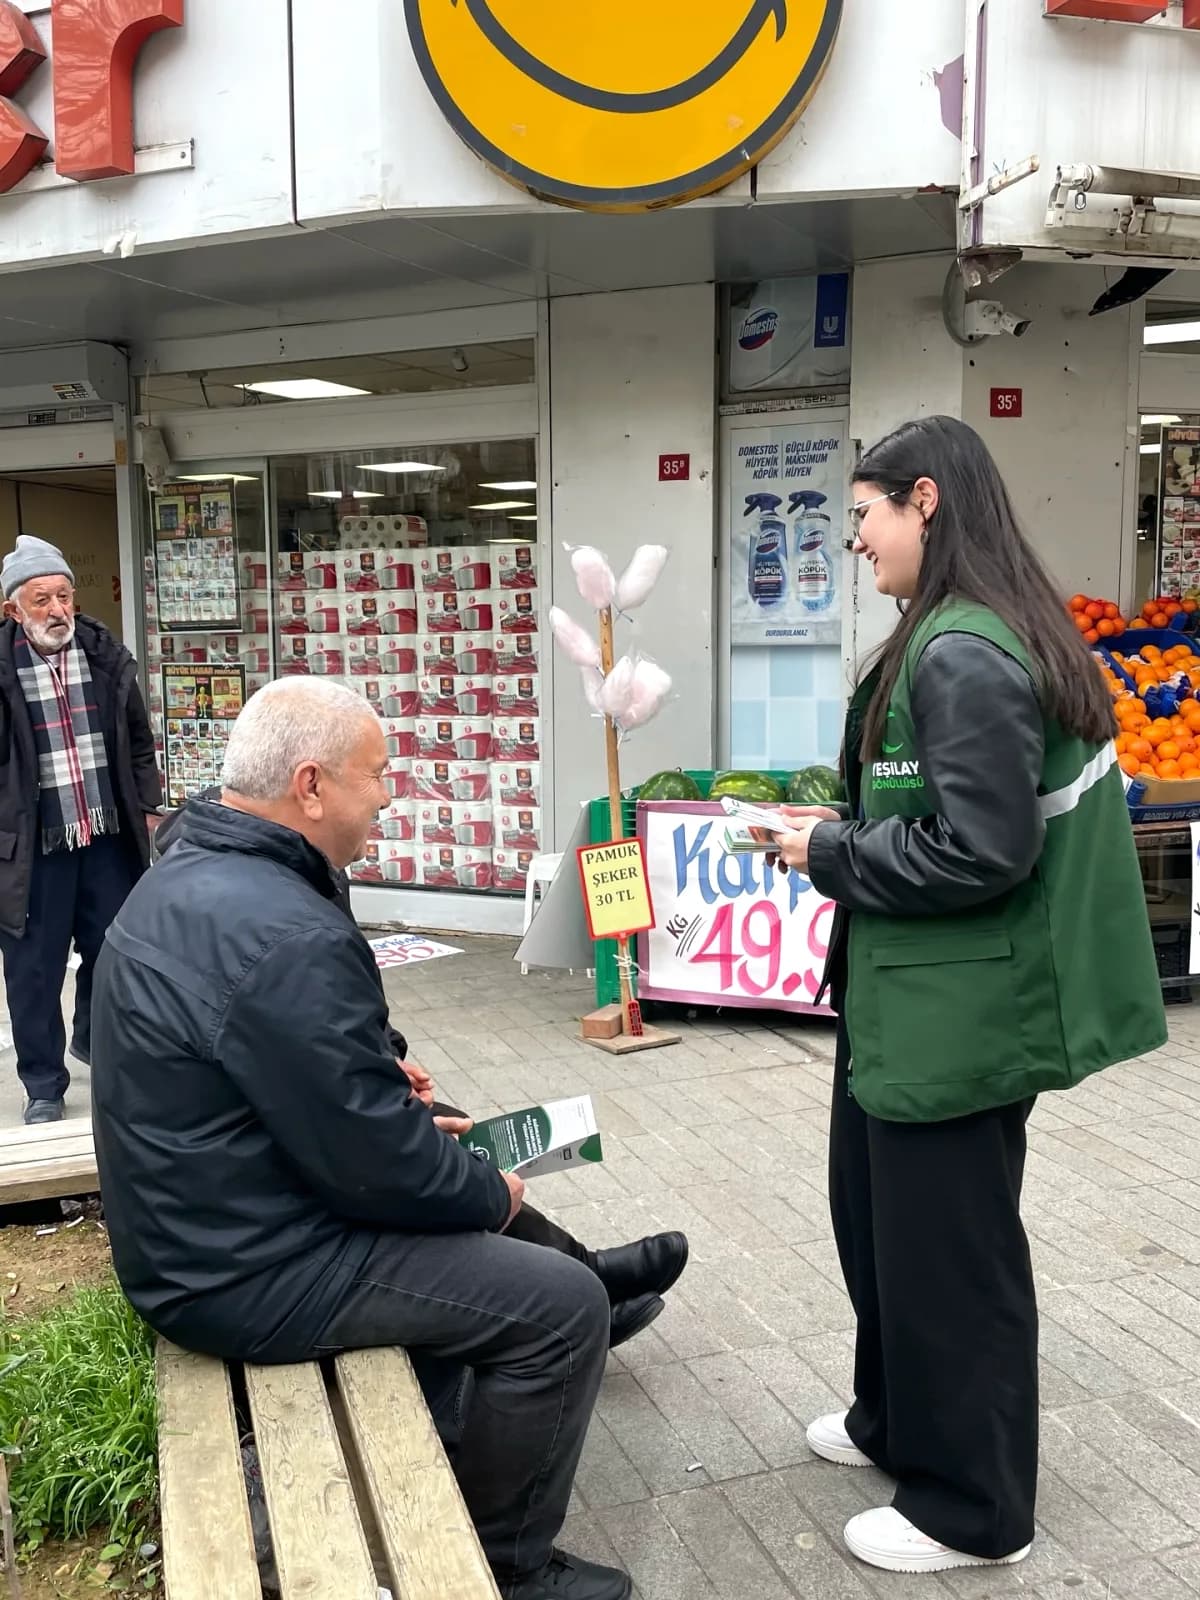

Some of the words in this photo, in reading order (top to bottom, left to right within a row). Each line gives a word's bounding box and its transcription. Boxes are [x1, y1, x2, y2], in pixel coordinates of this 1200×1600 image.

[738, 444, 779, 457] DOMESTOS
[785, 440, 811, 454] GÜÇLÜ
[812, 438, 839, 451] KÖPÜK
[785, 453, 828, 466] MAKSİMUM
[752, 467, 779, 479] KÖPÜK
[585, 845, 638, 864] PAMUK
[592, 866, 638, 888] ŞEKER
[595, 893, 613, 906] 30
[616, 889, 635, 902] TL
[666, 914, 689, 939] KG
